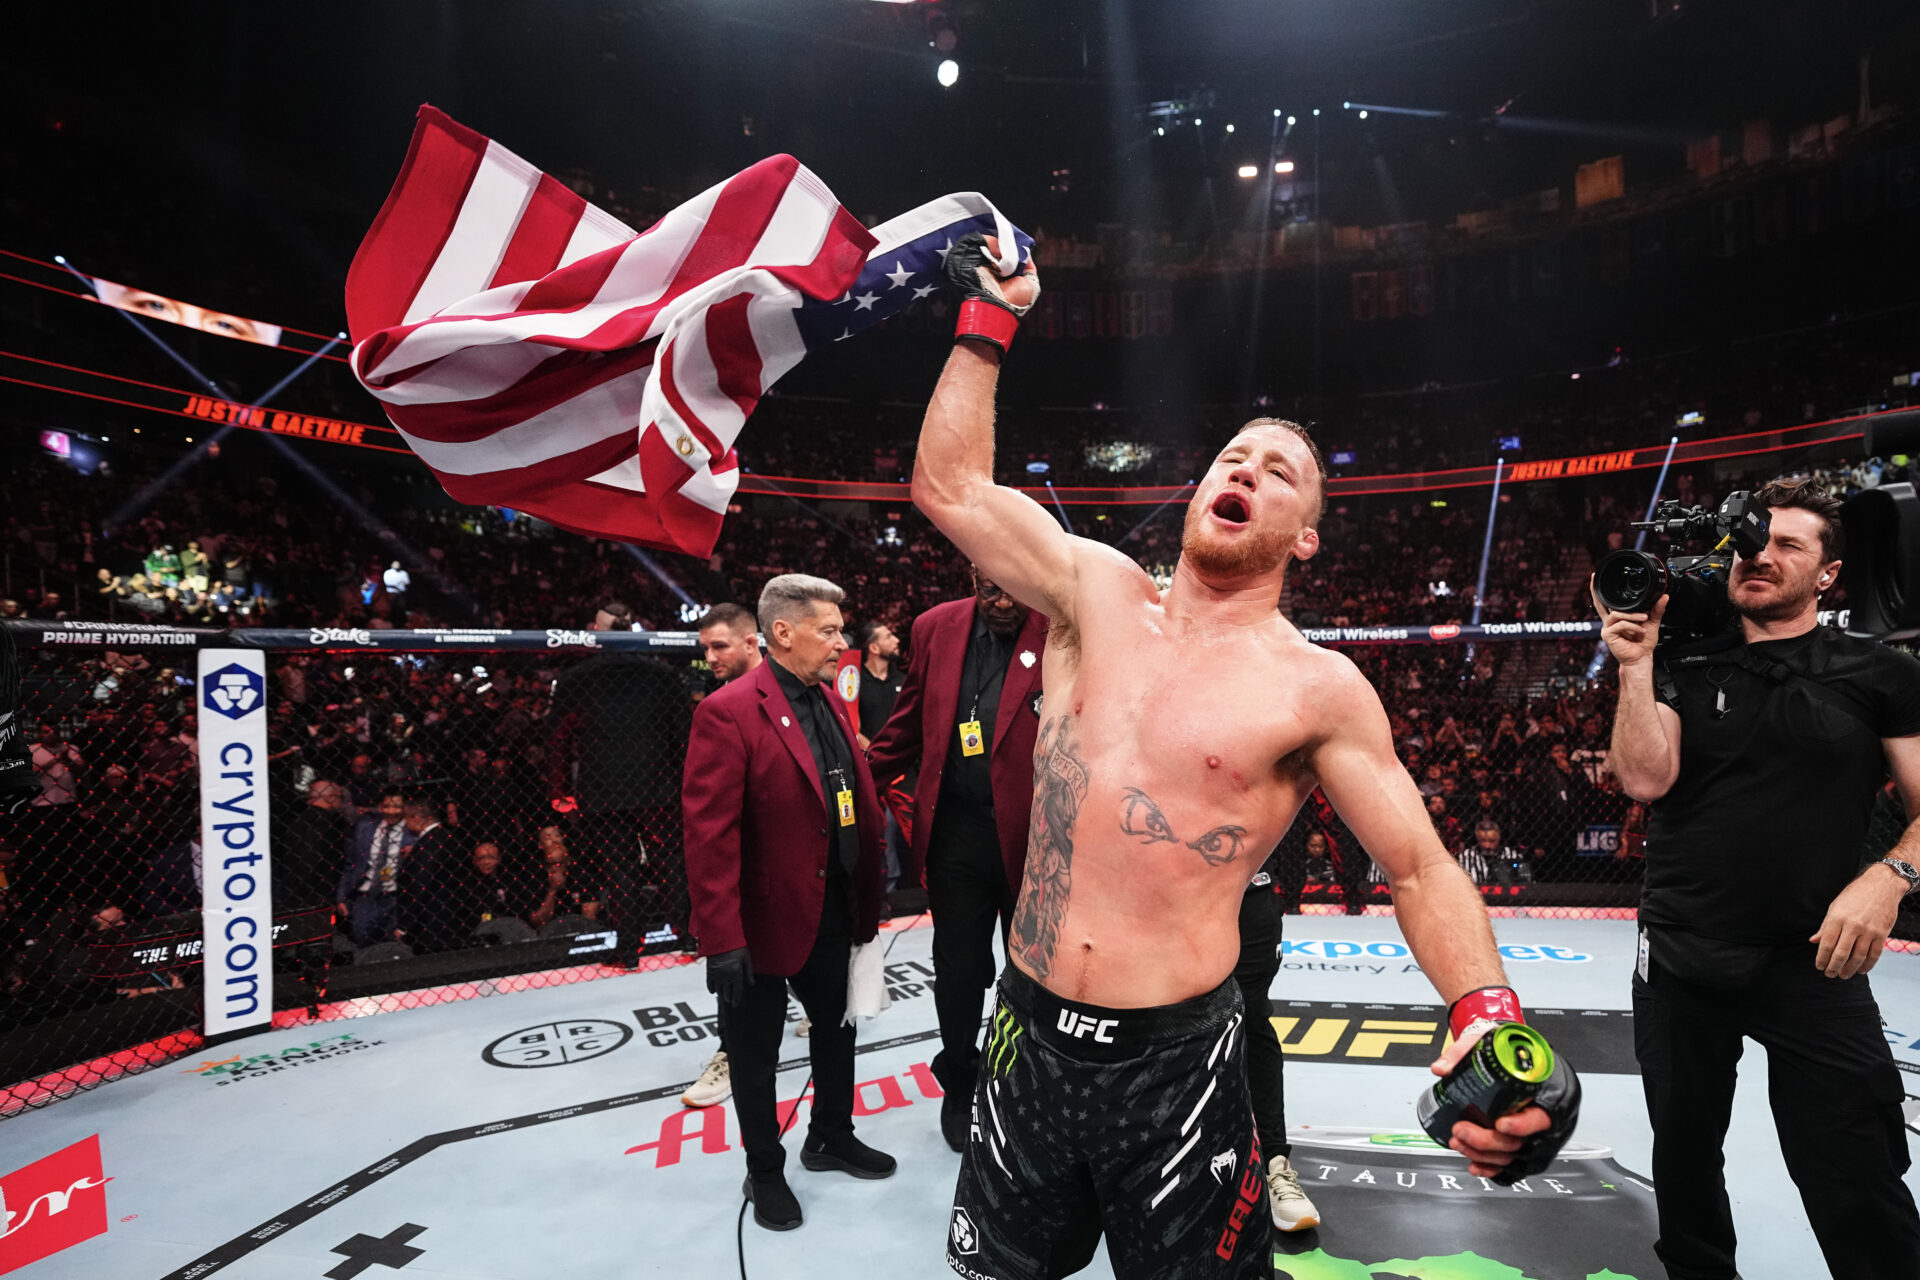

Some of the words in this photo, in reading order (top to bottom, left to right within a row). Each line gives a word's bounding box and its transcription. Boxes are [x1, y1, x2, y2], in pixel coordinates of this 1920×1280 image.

[183, 396, 266, 428] JUSTIN
[271, 412, 365, 444] GAETHJE
[1509, 460, 1563, 480] JUSTIN
[1567, 452, 1635, 474] GAETHJE
[42, 631, 103, 645] PRIME
[106, 632, 197, 646] HYDRATION
[309, 627, 371, 645] Stake
[545, 629, 597, 648] Stake
[1302, 628, 1340, 641] Total
[1343, 628, 1409, 640] Wireless
[1481, 622, 1522, 634] Total
[1525, 621, 1592, 633] Wireless
[212, 742, 263, 1019] crypto.com
[1283, 962, 1386, 975] ottery
[1057, 1008, 1119, 1044] UFC
[1268, 1016, 1450, 1058] UF
[200, 1032, 356, 1077] DRAFT
[216, 1040, 387, 1087] SPORTSBOOK
[229, 1038, 364, 1077] KINGS
[1317, 1165, 1573, 1195] TAURINE
